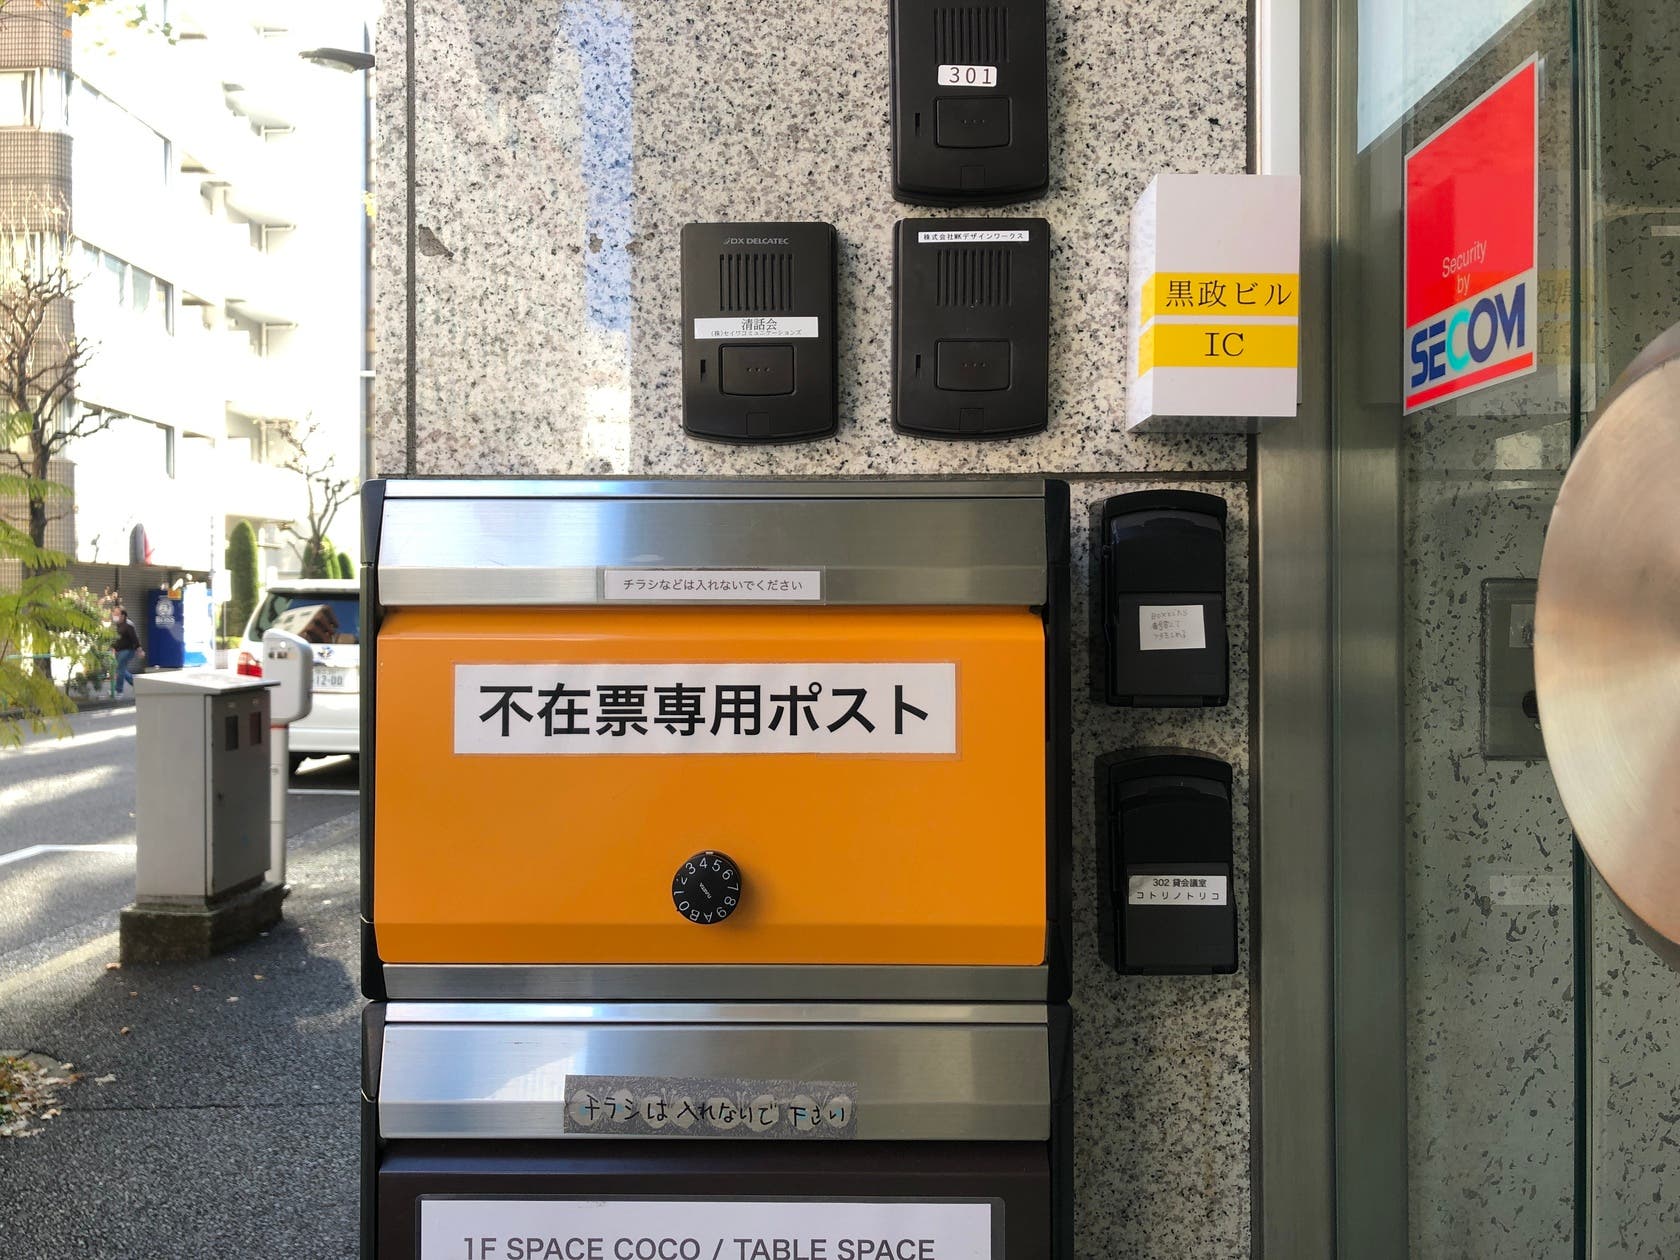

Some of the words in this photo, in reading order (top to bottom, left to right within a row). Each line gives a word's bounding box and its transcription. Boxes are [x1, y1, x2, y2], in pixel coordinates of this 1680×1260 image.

[949, 67, 992, 85] 301
[746, 237, 790, 245] DELCATEC
[1442, 240, 1487, 279] Security
[1166, 279, 1293, 308] 黒政ビル
[1457, 274, 1471, 296] by
[741, 318, 778, 331] 清話会
[1411, 282, 1526, 389] SECOM
[1204, 332, 1245, 357] IC
[623, 578, 803, 591] チラシなどは入れないでください
[479, 682, 929, 737] 不在票専用ポスト
[1153, 878, 1169, 887] 302
[1172, 879, 1207, 887] 貸会議室
[1136, 891, 1219, 900] コトリノトリコ
[464, 1238, 497, 1260] 1F
[506, 1237, 604, 1260] SPACE
[614, 1237, 701, 1260] COCO
[733, 1238, 827, 1260] TABLE
[837, 1238, 935, 1260] SPACE
